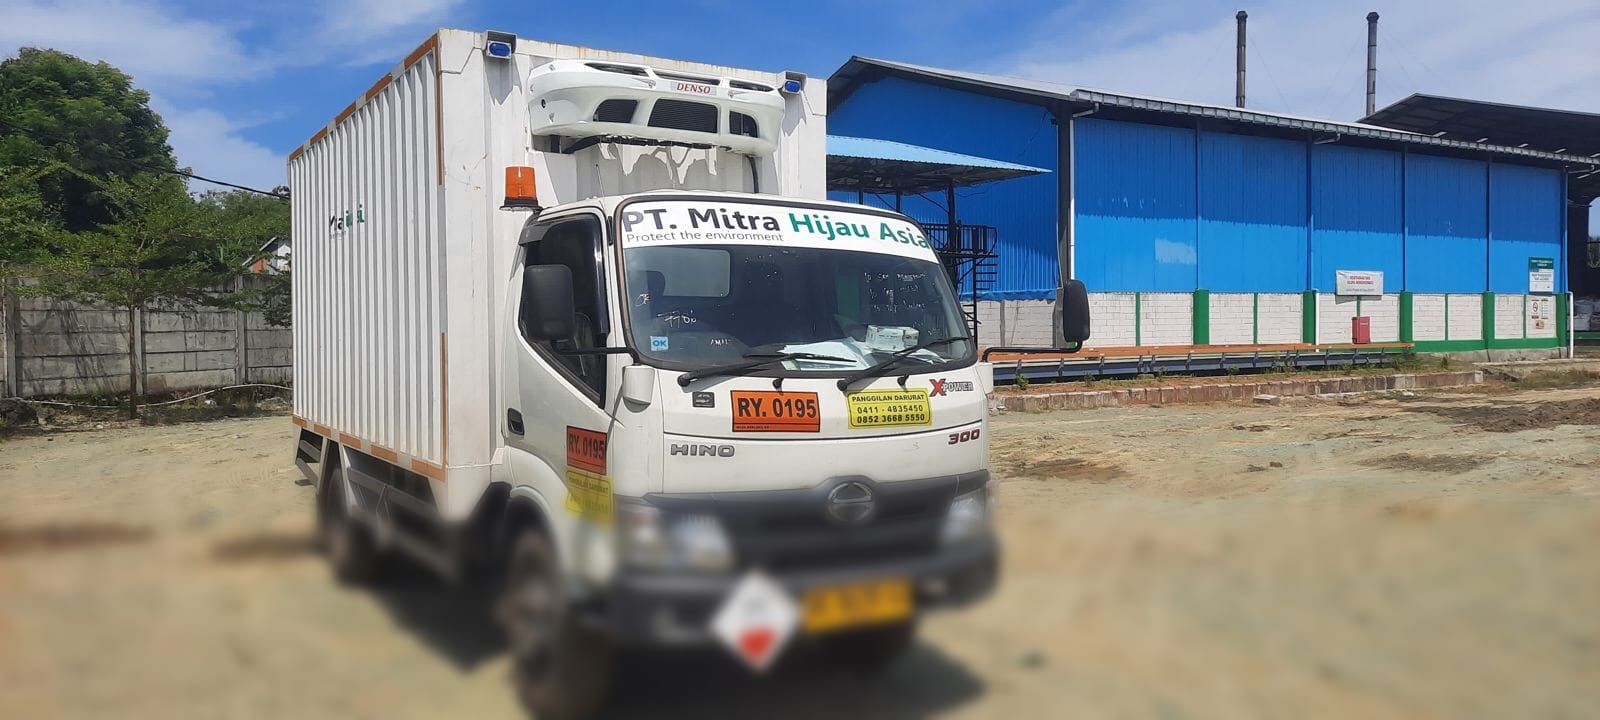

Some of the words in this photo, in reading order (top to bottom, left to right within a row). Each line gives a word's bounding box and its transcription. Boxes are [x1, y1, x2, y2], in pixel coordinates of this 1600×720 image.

[677, 82, 710, 94] DENSO
[622, 208, 677, 232] PT.
[688, 208, 780, 231] Mitra
[788, 213, 870, 241] Hijau
[879, 222, 931, 249] Asia
[627, 232, 676, 242] Protect
[680, 231, 701, 240] the
[705, 232, 784, 242] environment
[737, 398, 767, 417] RY.
[772, 398, 817, 418] 0195
[857, 406, 879, 414] 0411
[887, 404, 924, 413] 4835450
[857, 415, 879, 424] 0852
[905, 413, 925, 421] 5550
[948, 429, 980, 445] 300
[568, 432, 581, 454] RY.
[582, 436, 604, 459] 0195
[670, 444, 735, 457] HINO
